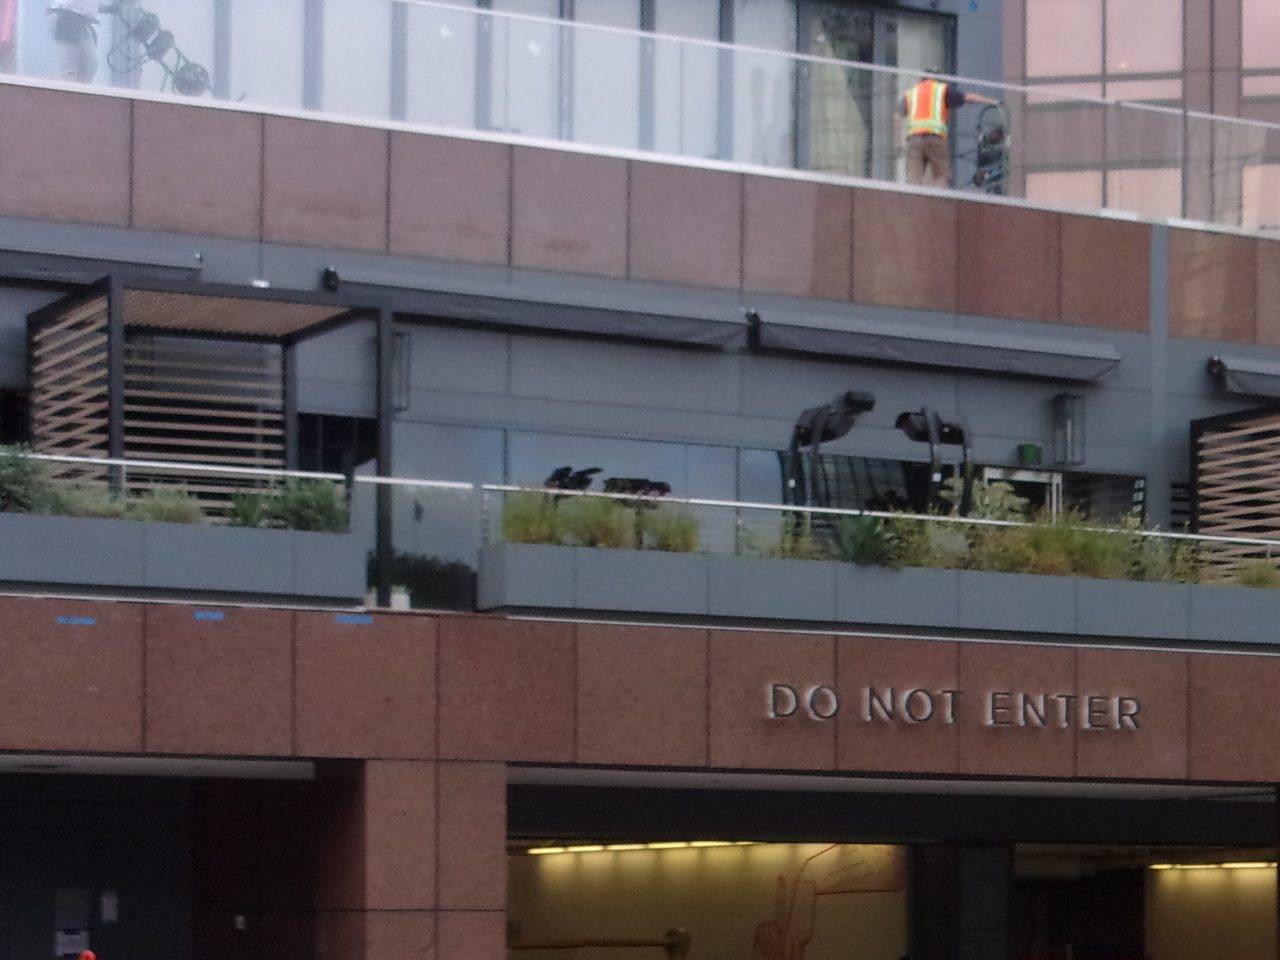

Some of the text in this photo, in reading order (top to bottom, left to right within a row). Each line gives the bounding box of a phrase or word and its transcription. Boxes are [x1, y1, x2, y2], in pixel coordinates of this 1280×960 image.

[767, 682, 1142, 731] DO NOT ENTER
